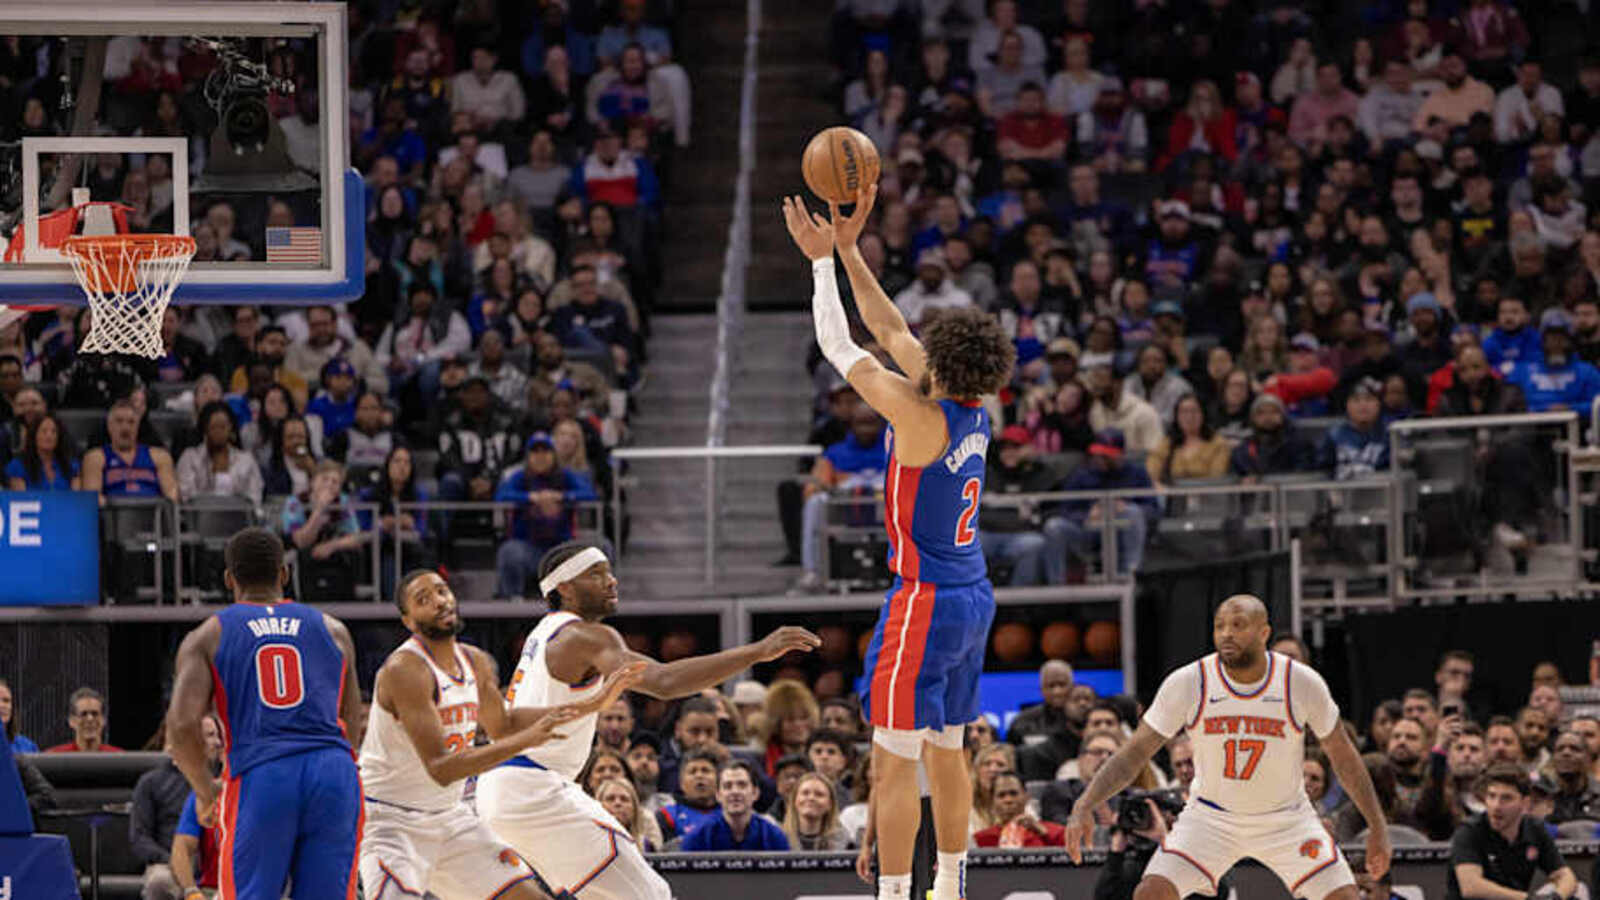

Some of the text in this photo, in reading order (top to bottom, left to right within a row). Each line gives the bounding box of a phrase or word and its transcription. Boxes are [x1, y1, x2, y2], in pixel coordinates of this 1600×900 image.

[0, 501, 42, 546] E
[954, 477, 981, 547] 2
[247, 617, 302, 637] DUREN
[255, 643, 305, 709] 0
[1204, 715, 1286, 739] NEW YORK
[1223, 738, 1266, 781] 17
